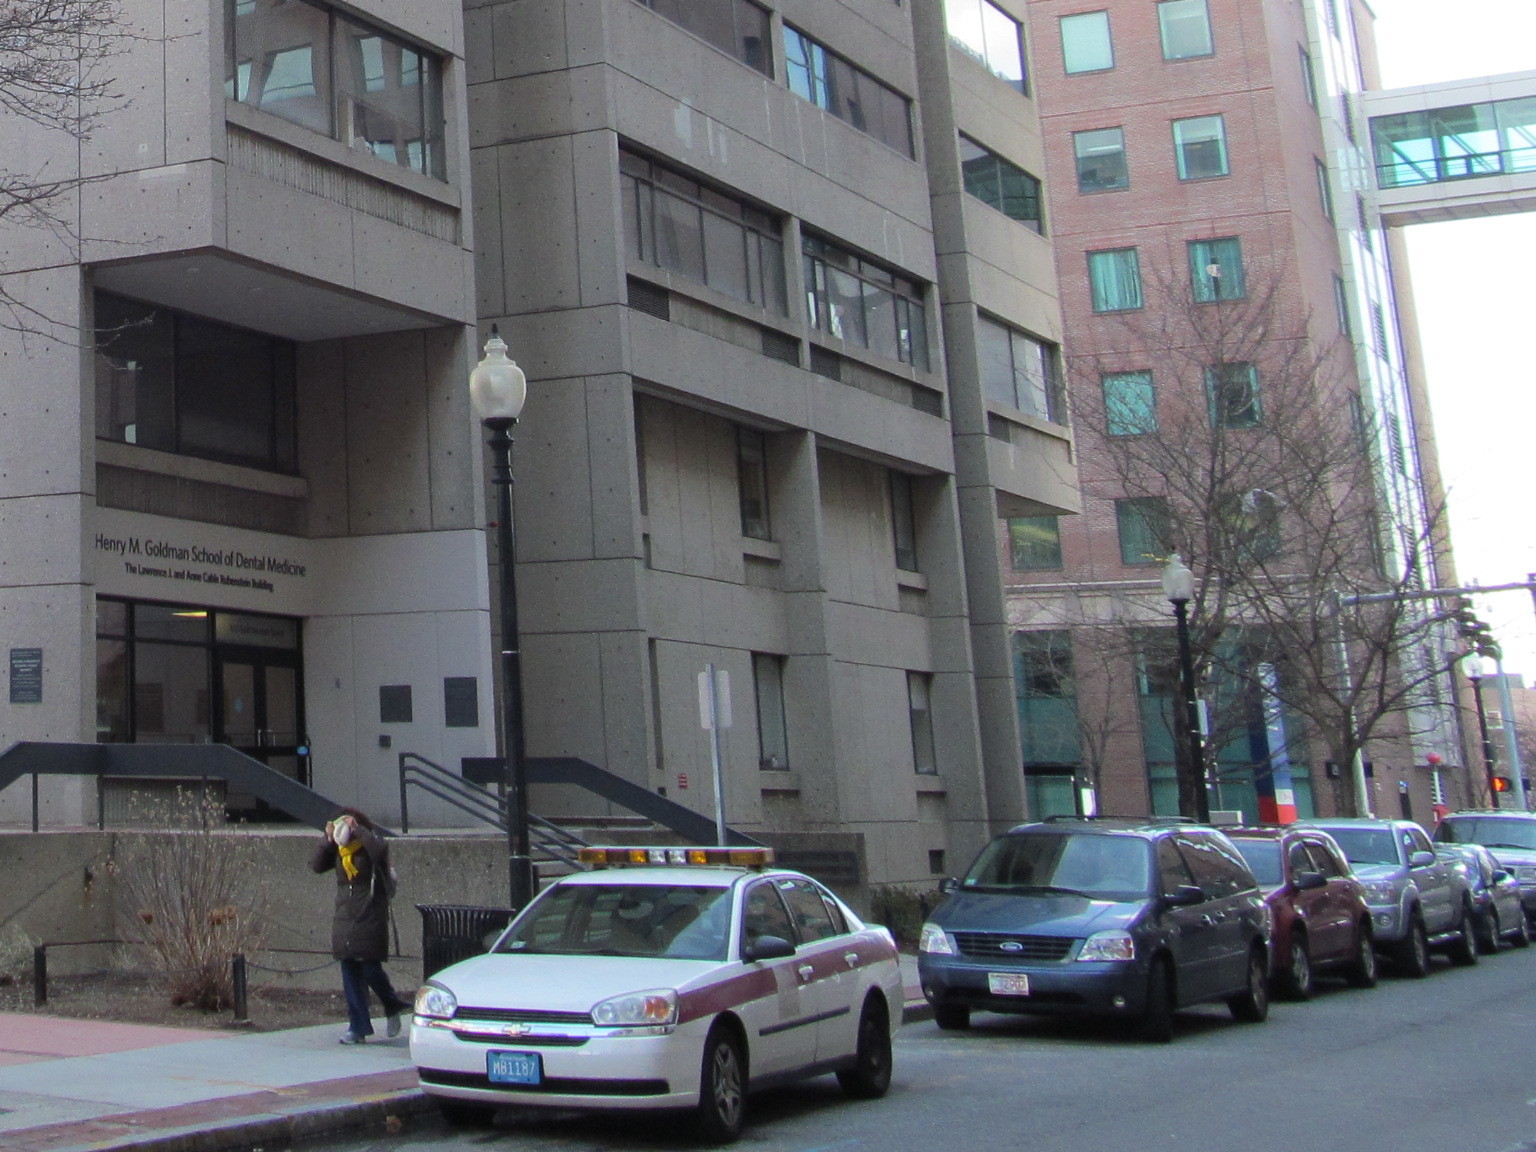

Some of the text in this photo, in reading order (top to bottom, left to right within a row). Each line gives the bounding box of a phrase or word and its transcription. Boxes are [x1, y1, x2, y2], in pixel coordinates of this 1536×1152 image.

[95, 533, 306, 576] Henry M. Goldman School of Dental Medicine
[125, 562, 137, 574] The
[138, 564, 167, 577] Lawrence
[173, 569, 185, 580] and
[186, 570, 201, 582] Anne
[252, 578, 274, 592] Building
